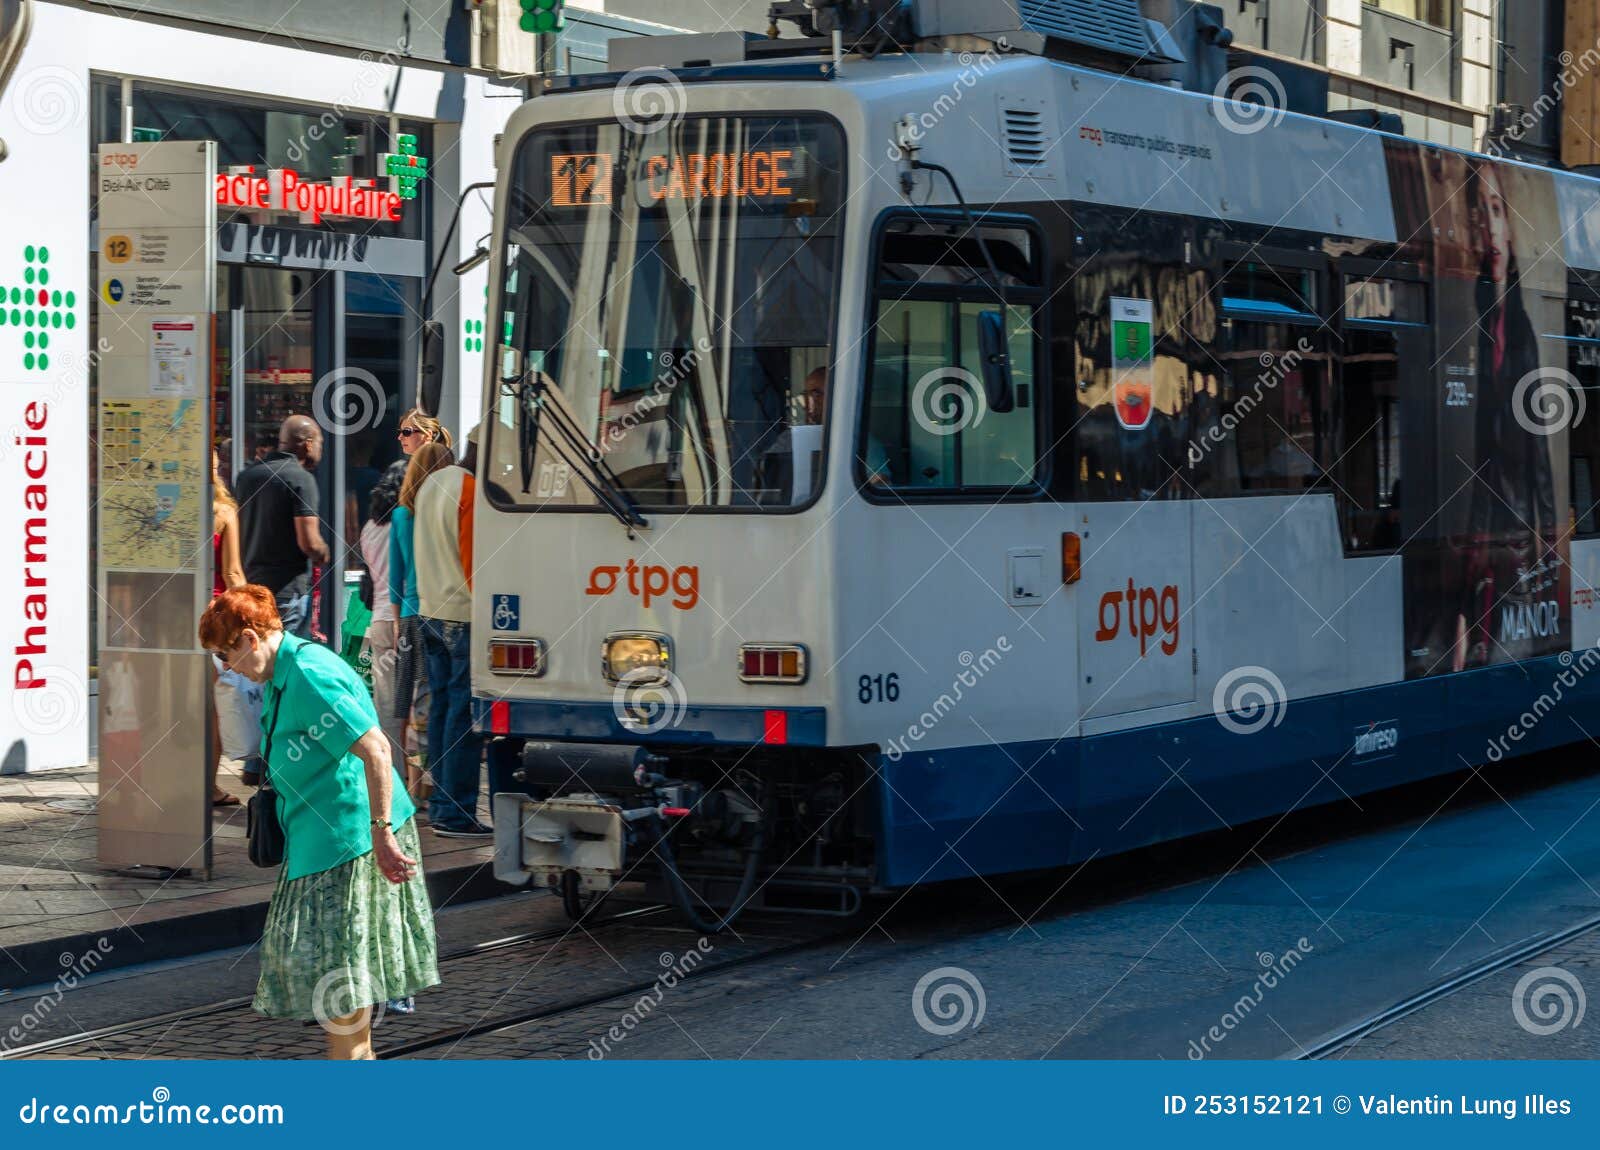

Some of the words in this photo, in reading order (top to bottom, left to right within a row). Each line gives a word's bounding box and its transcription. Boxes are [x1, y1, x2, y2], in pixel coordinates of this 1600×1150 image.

[216, 165, 271, 209] acie
[281, 167, 402, 225] Populaire
[556, 155, 611, 204] 12
[647, 151, 793, 199] CAROUGE
[109, 241, 128, 258] 12
[14, 400, 48, 690] Pharmacie
[1500, 600, 1560, 641] MANOR
[858, 672, 900, 704] 816
